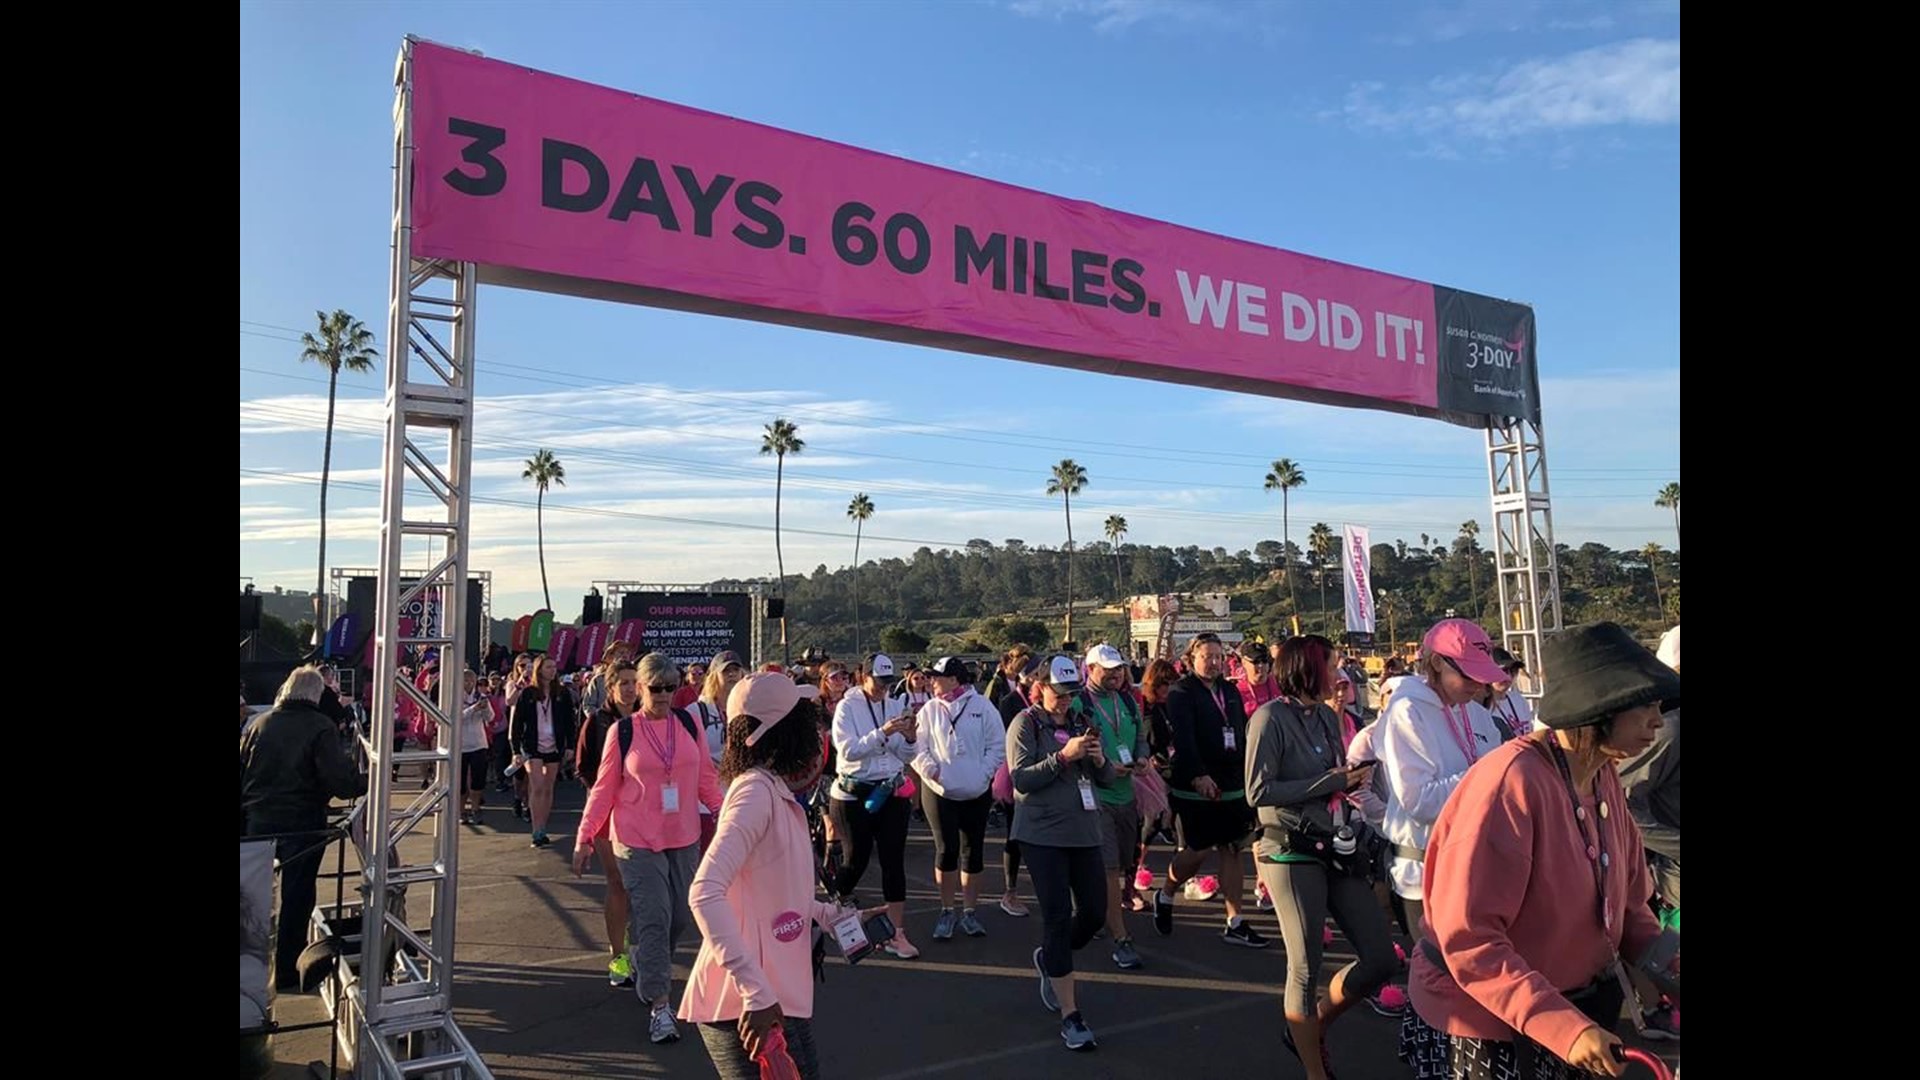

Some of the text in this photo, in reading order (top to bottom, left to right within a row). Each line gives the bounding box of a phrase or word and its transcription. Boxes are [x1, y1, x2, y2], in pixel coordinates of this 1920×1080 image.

[443, 117, 1425, 365] 3 DAYS. 60 MILES. WE DID IT!
[649, 606, 727, 615] OUR PROMISE:
[646, 620, 730, 628] TOGETHER IN BODY
[660, 629, 694, 637] UNITED
[695, 629, 704, 637] IN
[706, 629, 735, 638] SPIRIT,
[711, 638, 730, 646] OUR
[772, 917, 804, 937] FIRST
